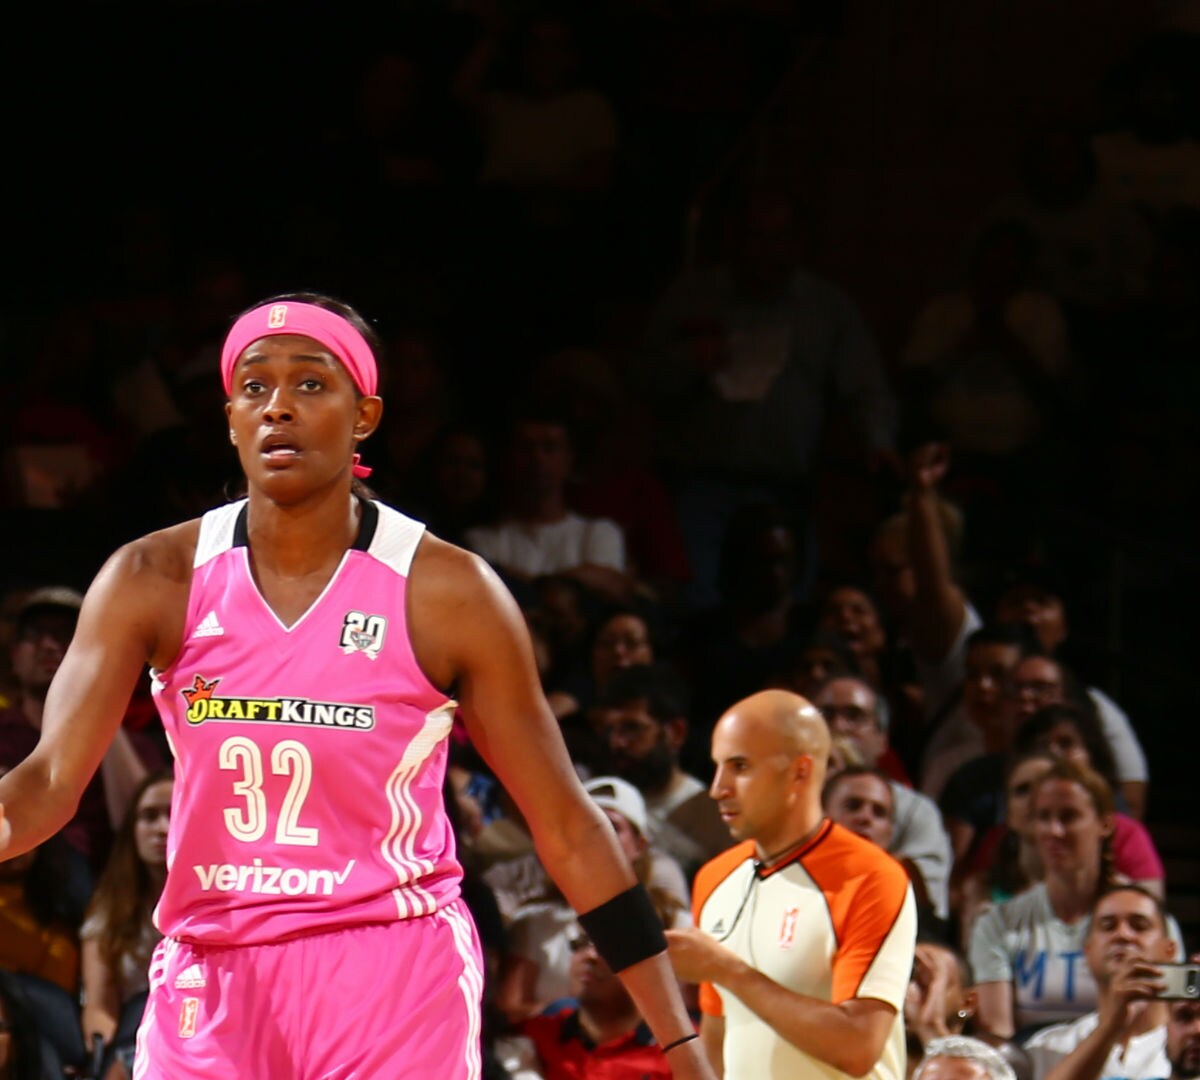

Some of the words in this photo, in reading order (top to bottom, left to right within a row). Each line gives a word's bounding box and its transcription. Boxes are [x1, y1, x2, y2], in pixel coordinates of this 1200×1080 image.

[342, 610, 387, 652] 20
[187, 699, 373, 728] DRAFTKINGS
[219, 736, 319, 846] 32
[193, 858, 335, 895] verizon
